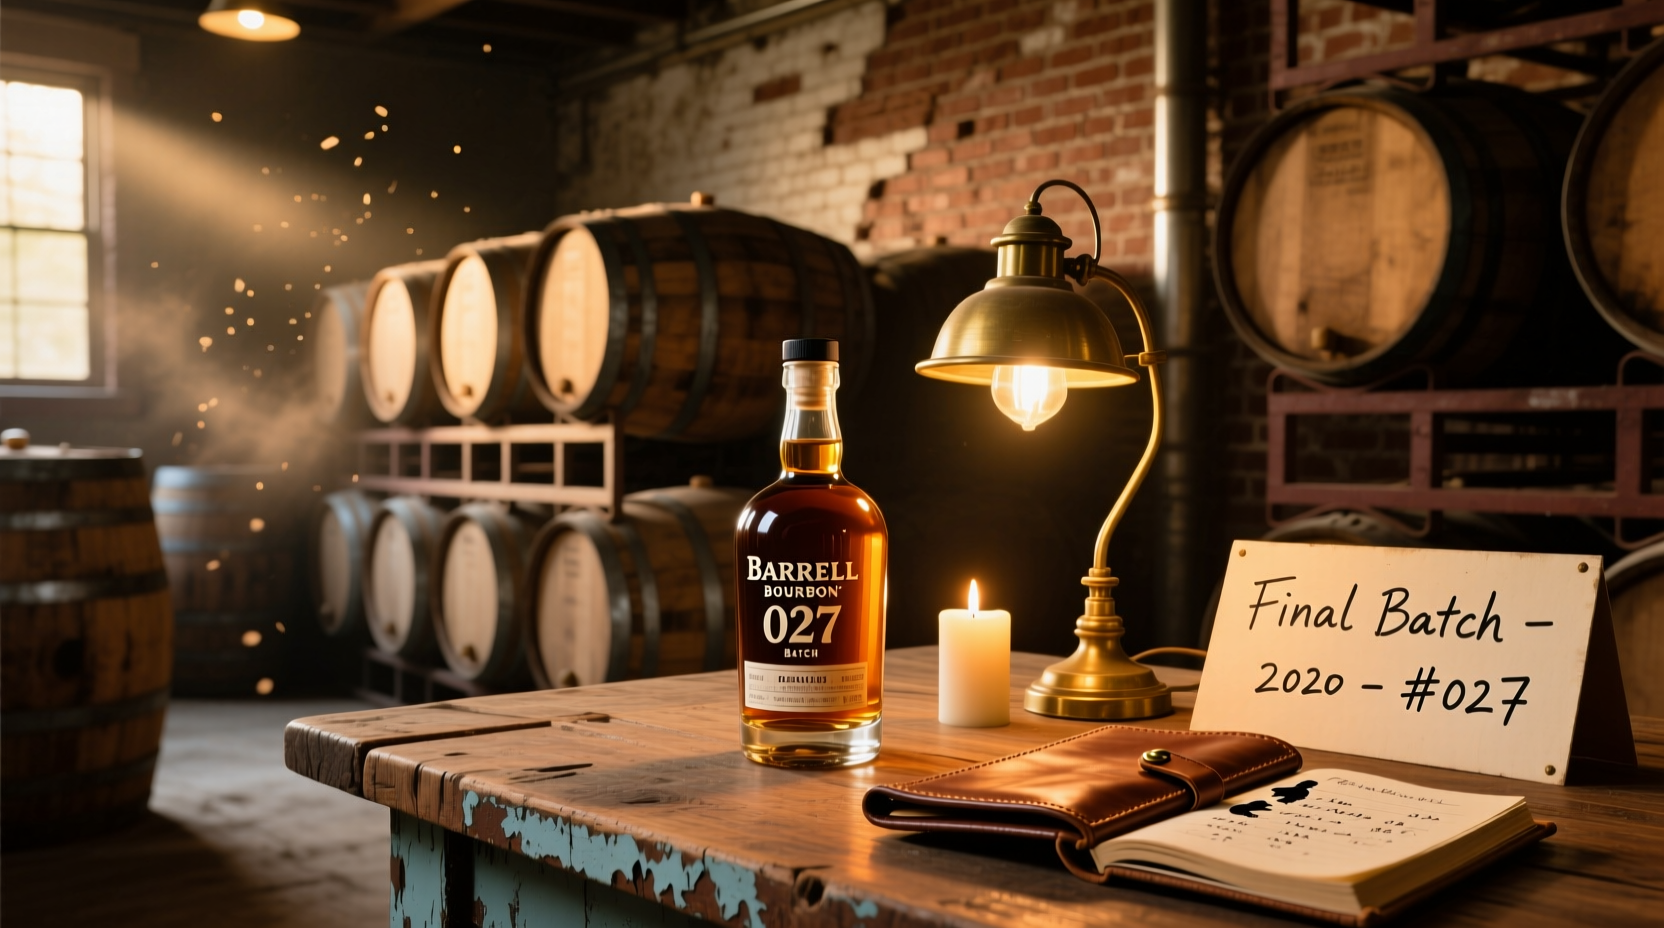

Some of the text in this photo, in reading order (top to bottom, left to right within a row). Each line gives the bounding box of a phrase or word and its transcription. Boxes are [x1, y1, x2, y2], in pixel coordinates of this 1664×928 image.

[746, 555, 859, 582] BARRELL
[763, 605, 842, 644] 027
[1249, 576, 1358, 631] Final
[1374, 587, 1504, 643] Batch
[784, 648, 818, 658] BATCH
[1254, 662, 1344, 695] 2020
[1400, 665, 1531, 726] #027
